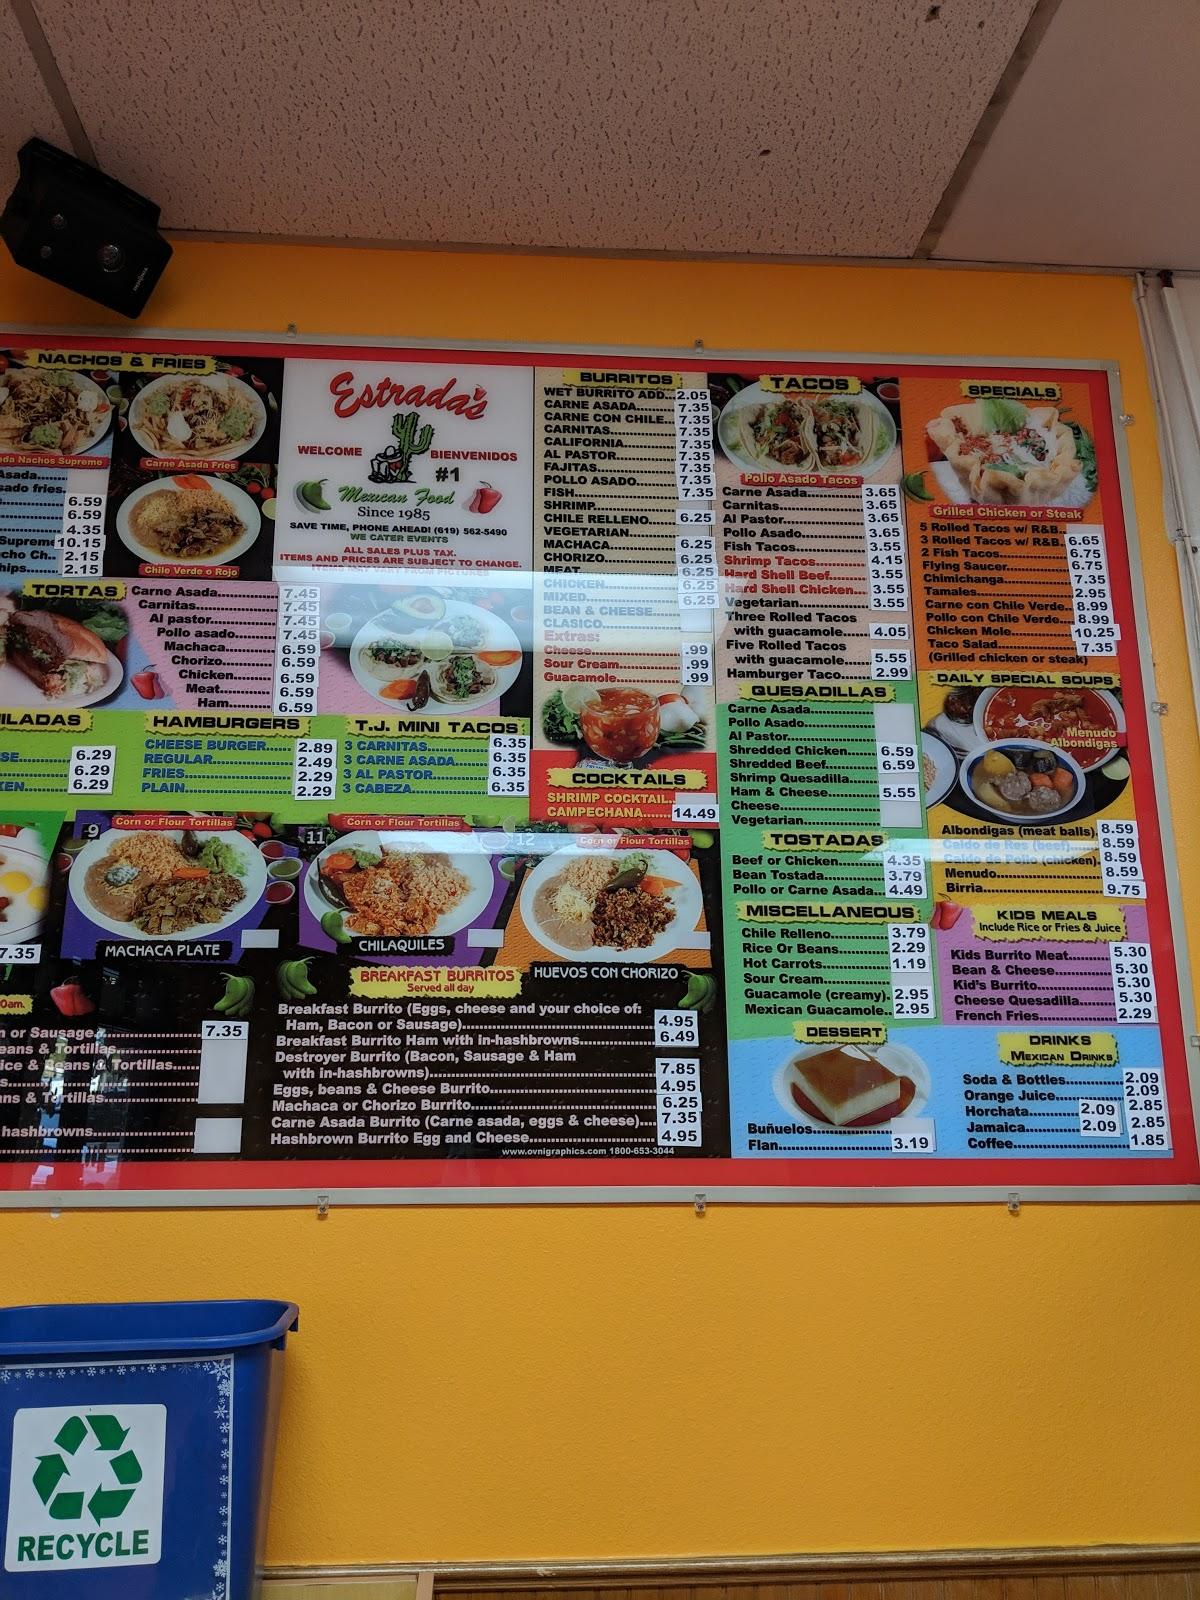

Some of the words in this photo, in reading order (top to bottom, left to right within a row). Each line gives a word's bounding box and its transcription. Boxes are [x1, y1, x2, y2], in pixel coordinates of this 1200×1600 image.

[38, 353, 122, 366] NACHOS
[130, 358, 143, 366] &
[152, 358, 206, 369] FRIES
[580, 372, 672, 384] BURRITOS
[770, 378, 849, 390] TACOS
[330, 371, 488, 420] Estrada's
[544, 388, 572, 396] WET
[577, 389, 634, 398] BURRITO
[677, 391, 707, 400] 2.05
[969, 386, 1056, 397] SPECIALS
[678, 404, 709, 412] 7.35
[298, 446, 362, 456] WELCOME
[431, 450, 517, 461] BIENVENIDOS
[19, 456, 55, 465] Nachos
[58, 457, 103, 467] Supreme
[146, 460, 175, 468] Carne
[177, 460, 209, 469] Asada
[211, 461, 236, 470] Fries
[436, 467, 460, 482] #1
[544, 475, 587, 484] POLLO
[745, 475, 775, 483] Pollo
[779, 475, 816, 484] Asado
[820, 476, 857, 484] Tacos
[680, 476, 711, 484] 7.35
[339, 486, 408, 503] Mexican
[414, 488, 456, 506] Food
[866, 488, 896, 496] 3.65
[68, 497, 102, 506] 6.59
[358, 506, 394, 518] Since
[399, 508, 430, 520] 1985
[680, 514, 711, 522] 6.25
[934, 508, 974, 516] Grilled
[978, 508, 1026, 517] Chicken
[1047, 510, 1082, 519] Steak
[66, 525, 100, 534] 4.35
[290, 522, 318, 530] SAVE
[321, 523, 349, 532] TIME,
[352, 524, 390, 532] PHONE
[392, 525, 431, 533] AHEAD!
[434, 526, 459, 535] (619)
[463, 527, 507, 536] 562-5490
[57, 538, 100, 547] 10.15
[370, 534, 404, 542] CATER
[407, 535, 448, 543] EVENTS
[1069, 536, 1099, 546] 6.65
[344, 546, 363, 554] ALL
[367, 547, 400, 555] SALES
[403, 548, 431, 556] PLUS
[434, 549, 457, 557] TAX.
[316, 554, 339, 562] AND
[342, 555, 380, 564] PRICES
[383, 556, 404, 564] ARE
[407, 557, 456, 566] SUBJECT
[475, 559, 522, 568] CHANGE.
[724, 556, 771, 566] Shrimp
[872, 556, 902, 565] 4.15
[145, 566, 171, 575] Chile
[174, 567, 203, 576] Verde
[215, 567, 237, 577] Rojo
[32, 584, 118, 596] TORTAS
[1077, 602, 1108, 611] 8.99
[726, 612, 765, 621] Three
[770, 613, 812, 622] Rolled
[816, 614, 857, 622] Tacos
[875, 627, 906, 636] 4.05
[1075, 628, 1114, 638] 10.25
[1082, 643, 1113, 653] 7.35
[929, 653, 974, 664] (Grilled
[976, 654, 1028, 663] chicken
[1048, 655, 1088, 665] steak)
[687, 660, 708, 669] .99
[728, 669, 803, 680] Hamburger
[877, 668, 908, 677] 2.99
[938, 674, 984, 683] DAILY
[991, 674, 1056, 684] SPECIAL
[1062, 676, 1112, 685] SOUPS
[752, 686, 886, 696] QUESADILLAS
[278, 703, 313, 713] 6.59
[154, 716, 300, 730] HAMBURGERS
[356, 720, 390, 731] T.J.
[398, 721, 439, 732] MINI
[449, 722, 518, 733] TACOS
[1067, 728, 1116, 737] Menudo
[145, 740, 202, 750] CHEESE
[493, 738, 526, 748] 6.35
[1051, 738, 1117, 749] Albondigas
[76, 750, 111, 760] 6.29
[730, 746, 790, 755] Shredded
[882, 746, 914, 756] 6.59
[572, 773, 686, 785] COCKTAILS
[883, 788, 915, 798] 5.55
[674, 808, 716, 819] 14.49
[116, 817, 141, 826] Corn
[159, 818, 185, 826] Flour
[189, 818, 232, 827] Tortillas
[1101, 824, 1133, 834] 8.59
[307, 832, 325, 844] 11
[771, 834, 884, 846] TOSTADAS
[889, 872, 921, 881] 3.79
[1107, 885, 1140, 895] 9.75
[747, 905, 914, 918] MISCELLANEOUS
[998, 911, 1035, 920] KIDS
[1041, 911, 1097, 920] MEALS
[980, 923, 1015, 931] Include
[1017, 923, 1039, 931] Rice
[1055, 924, 1080, 932] Fries
[1083, 924, 1091, 932] &
[1095, 924, 1121, 932] Juice
[892, 928, 925, 938] 3.79
[359, 939, 445, 951] CHILAQUILES
[105, 945, 174, 957] MACHACA
[177, 945, 220, 956] PLATE
[951, 950, 980, 960] Kids
[985, 951, 1031, 960] Burrito
[1114, 947, 1146, 957] 5.30
[361, 970, 441, 982] BREAKFAST
[447, 971, 514, 982] BURRITOS
[534, 967, 588, 978] HUEVOS
[592, 968, 618, 978] CON
[622, 968, 678, 979] CHORIZO
[407, 984, 441, 992] Served
[457, 984, 474, 993] day
[278, 1004, 348, 1014] Breakfast
[353, 1004, 403, 1014] Burrito
[745, 1005, 802, 1015] Mexican
[895, 1004, 929, 1014] 2.95
[1118, 1009, 1152, 1018] 2.29
[659, 1016, 693, 1026] 4.95
[206, 1025, 242, 1036] 7.35
[807, 1028, 882, 1037] DESSERT
[1030, 1036, 1091, 1045] DRINKS
[276, 1052, 346, 1064] Destroyer
[351, 1052, 400, 1062] Burrito
[660, 1064, 695, 1074] 7.85
[1125, 1072, 1158, 1083] 2.09
[271, 1133, 353, 1144] Hashbrown
[662, 1131, 697, 1141] 4.95
[894, 1138, 928, 1150] 3.19
[502, 1147, 607, 1156] www.ovnigraphics.com
[18, 1530, 149, 1561] RECYCLE
